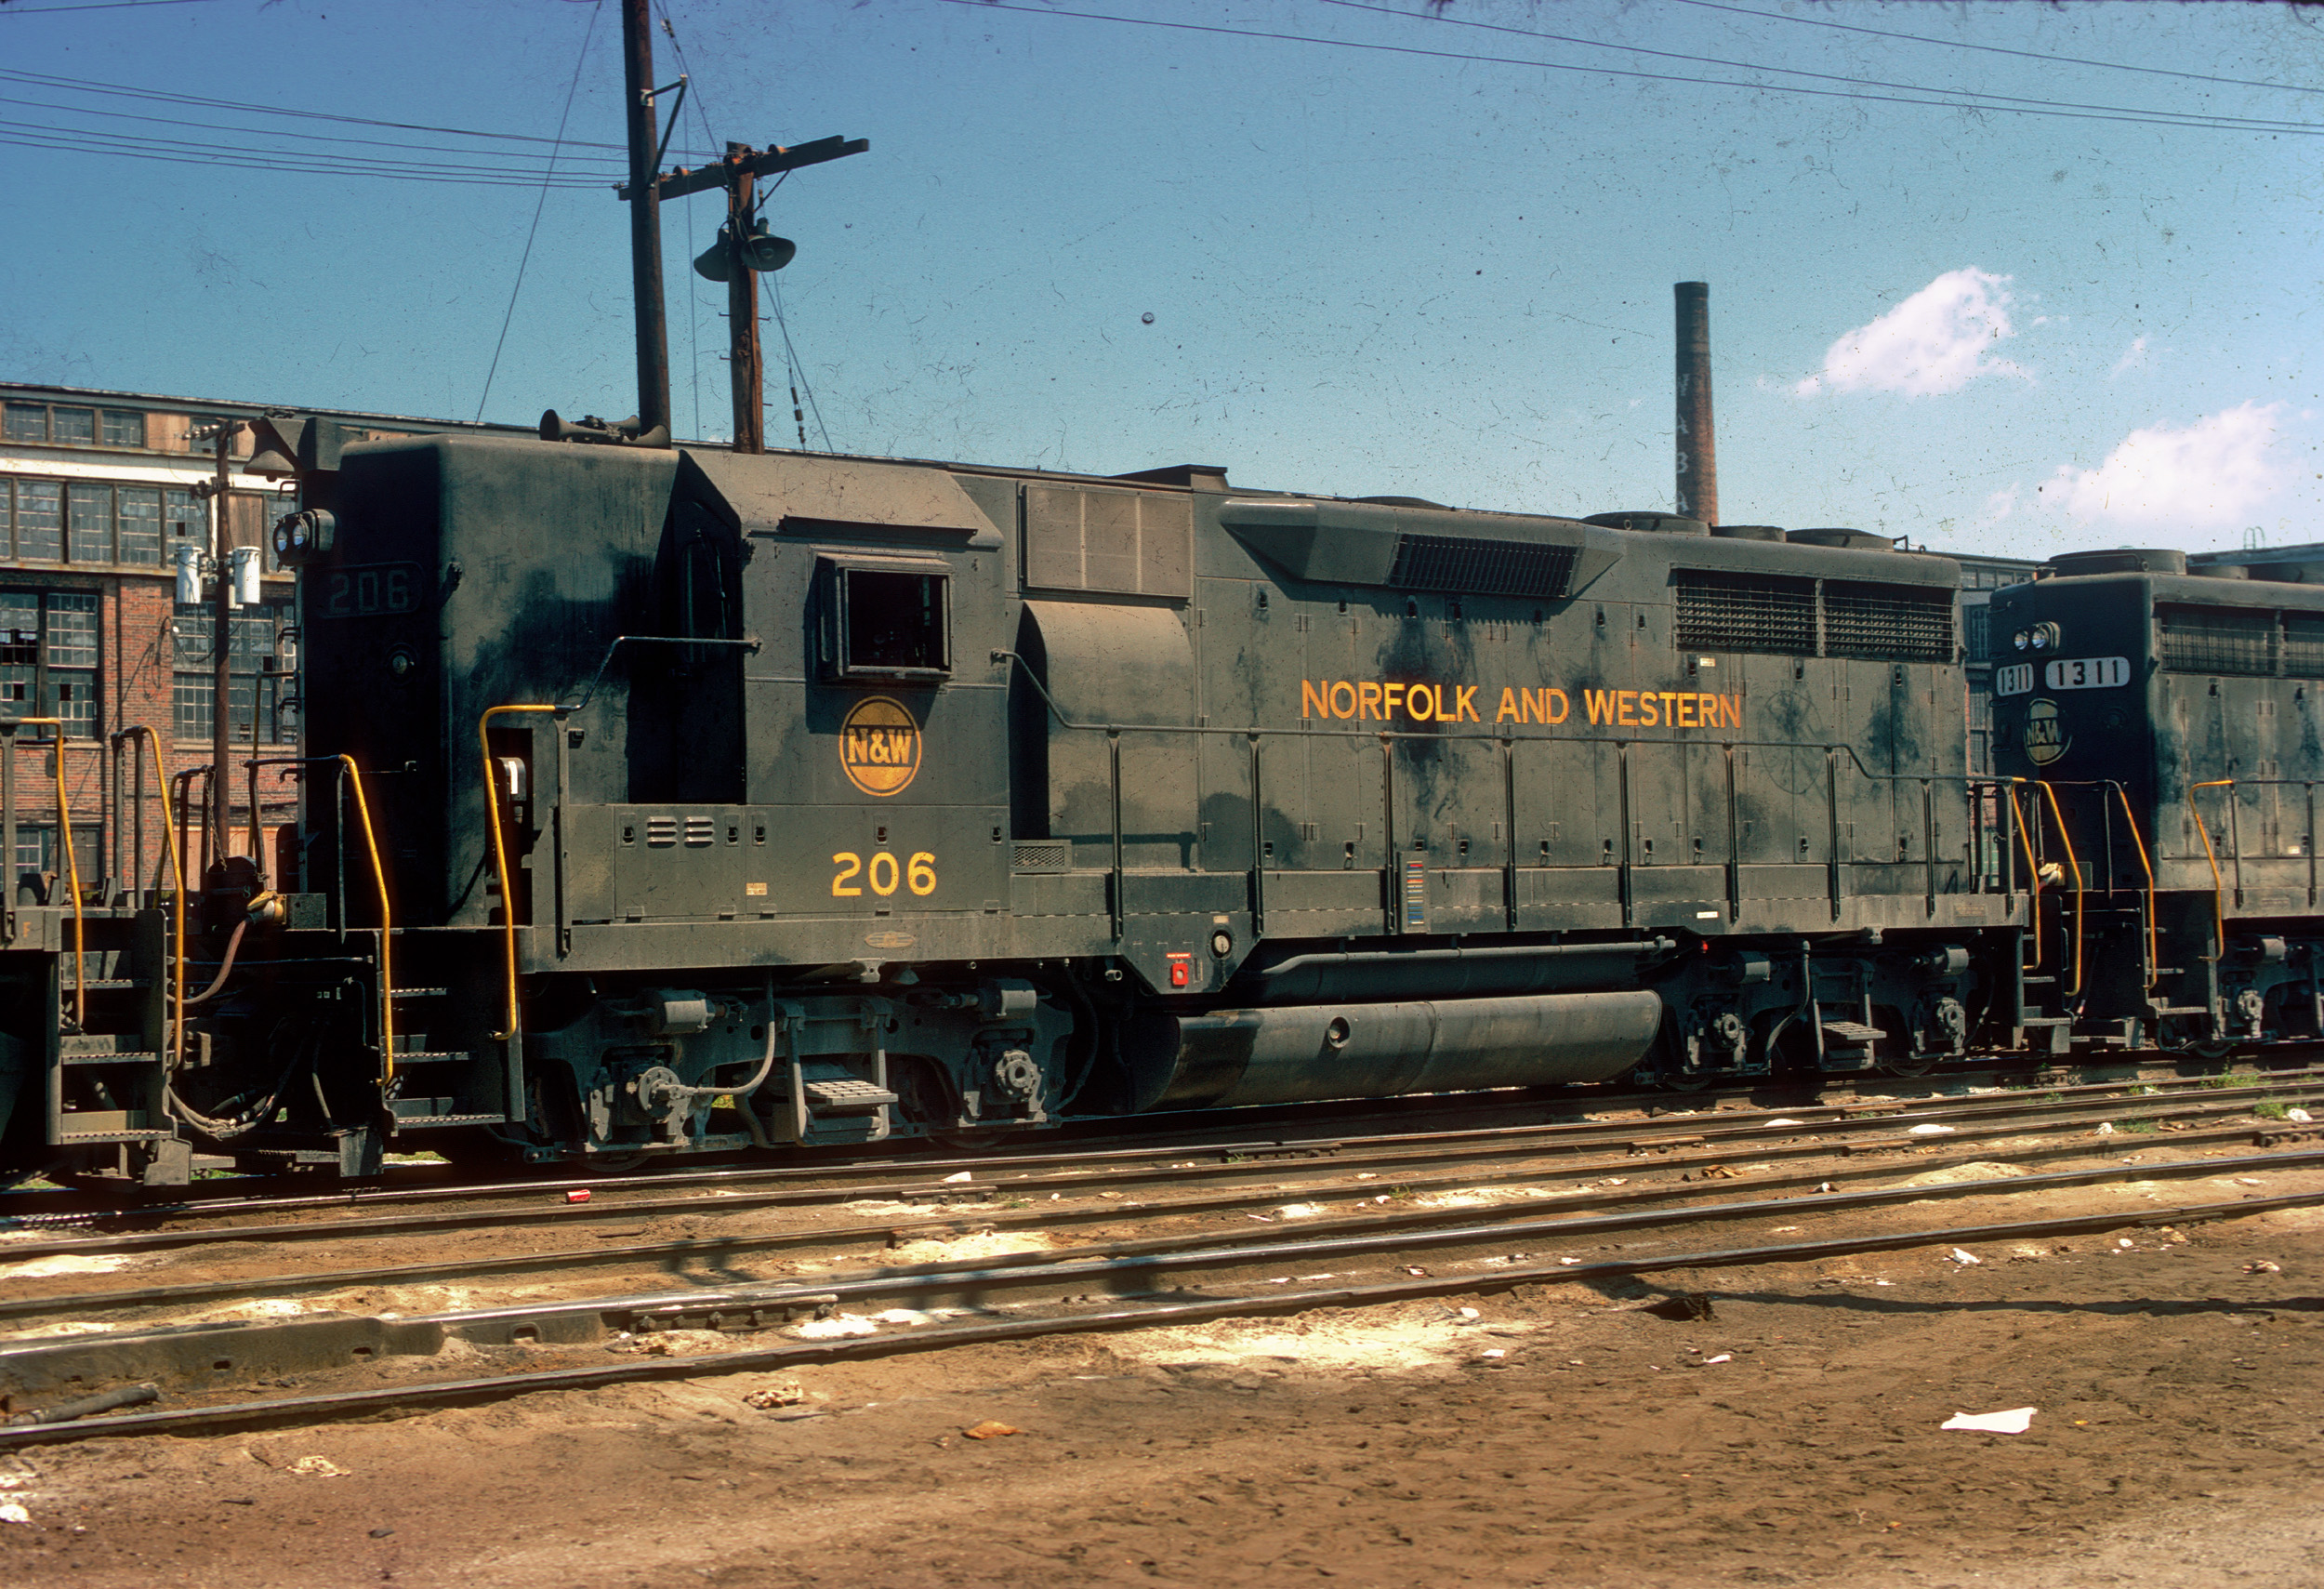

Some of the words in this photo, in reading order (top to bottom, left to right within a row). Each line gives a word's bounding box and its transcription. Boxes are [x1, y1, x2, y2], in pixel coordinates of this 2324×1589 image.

[330, 570, 409, 613] 206
[2000, 665, 2029, 693] 1311
[2057, 659, 2119, 686] 1311
[1301, 679, 1481, 722] NORFOLK
[1495, 686, 1570, 724] AND
[1583, 688, 1741, 728] WESTERN
[847, 728, 914, 764] N&W
[2026, 719, 2064, 745] N&W
[832, 852, 937, 896] 206
[22, 921, 32, 938] F
